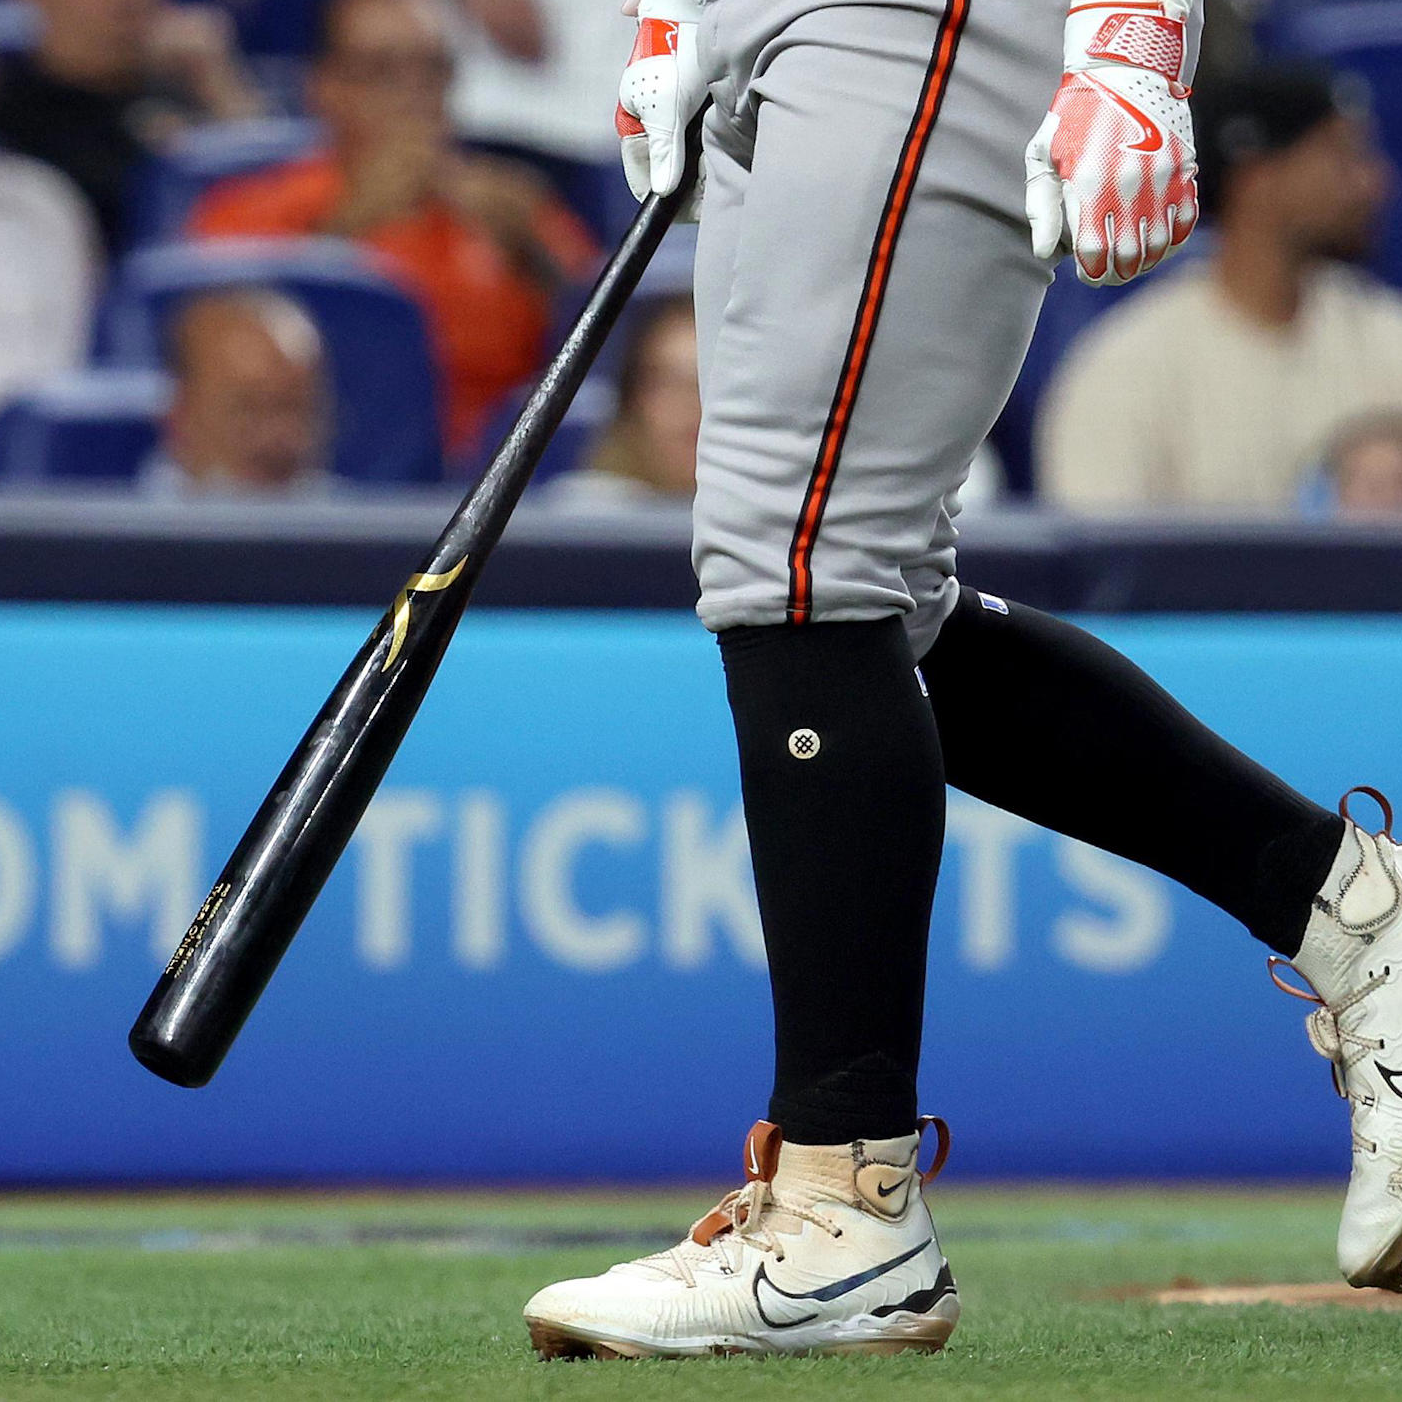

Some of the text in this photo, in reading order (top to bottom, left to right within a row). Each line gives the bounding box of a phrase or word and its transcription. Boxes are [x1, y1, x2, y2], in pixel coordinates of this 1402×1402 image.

[197, 882, 225, 921] TYLER
[353, 783, 1175, 974] TICKTS
[165, 925, 199, 975] O'NEILL
